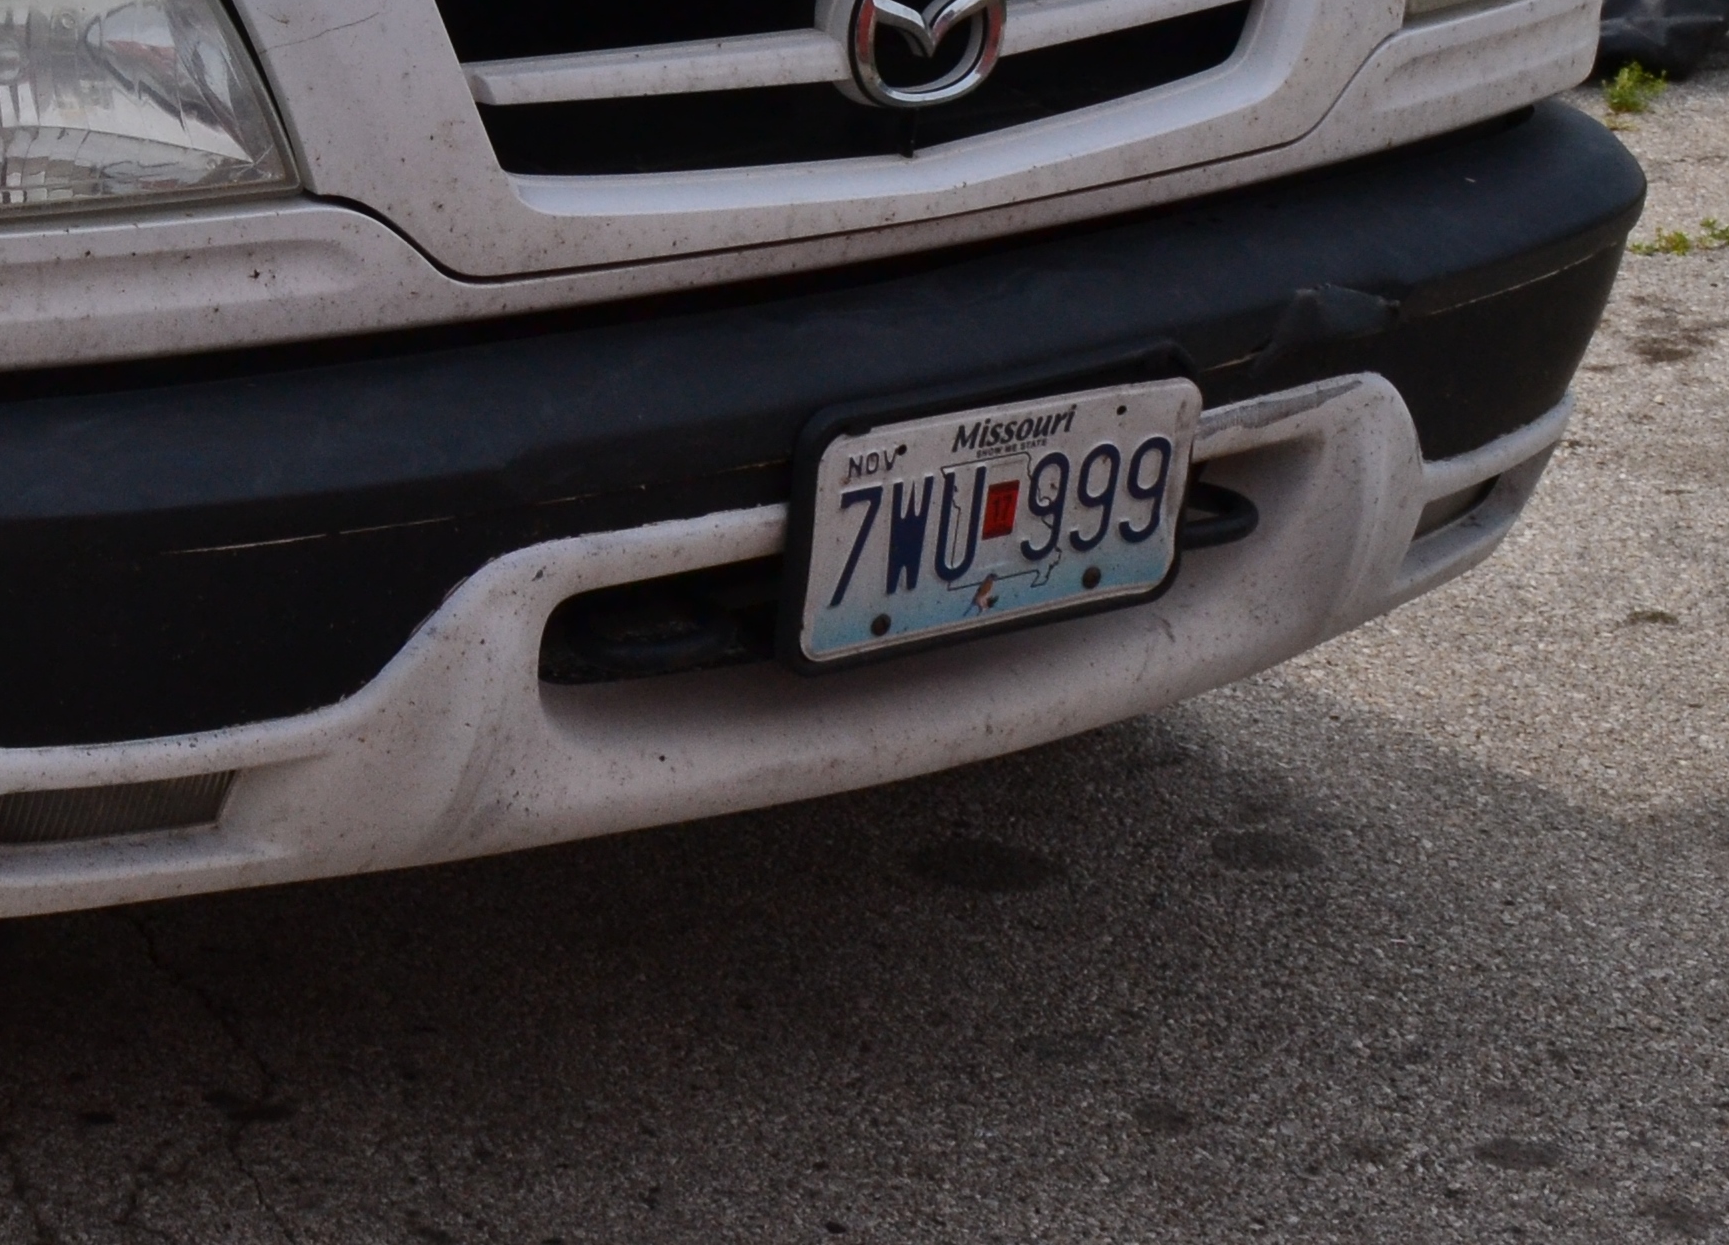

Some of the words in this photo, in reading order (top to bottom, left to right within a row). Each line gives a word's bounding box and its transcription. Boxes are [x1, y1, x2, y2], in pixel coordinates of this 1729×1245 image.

[951, 403, 1078, 453] Missouri
[847, 451, 899, 480] NOV
[976, 446, 1002, 459] SHOW
[1020, 438, 1048, 450] STATE
[829, 465, 987, 608] 7WU
[1019, 436, 1172, 562] 999
